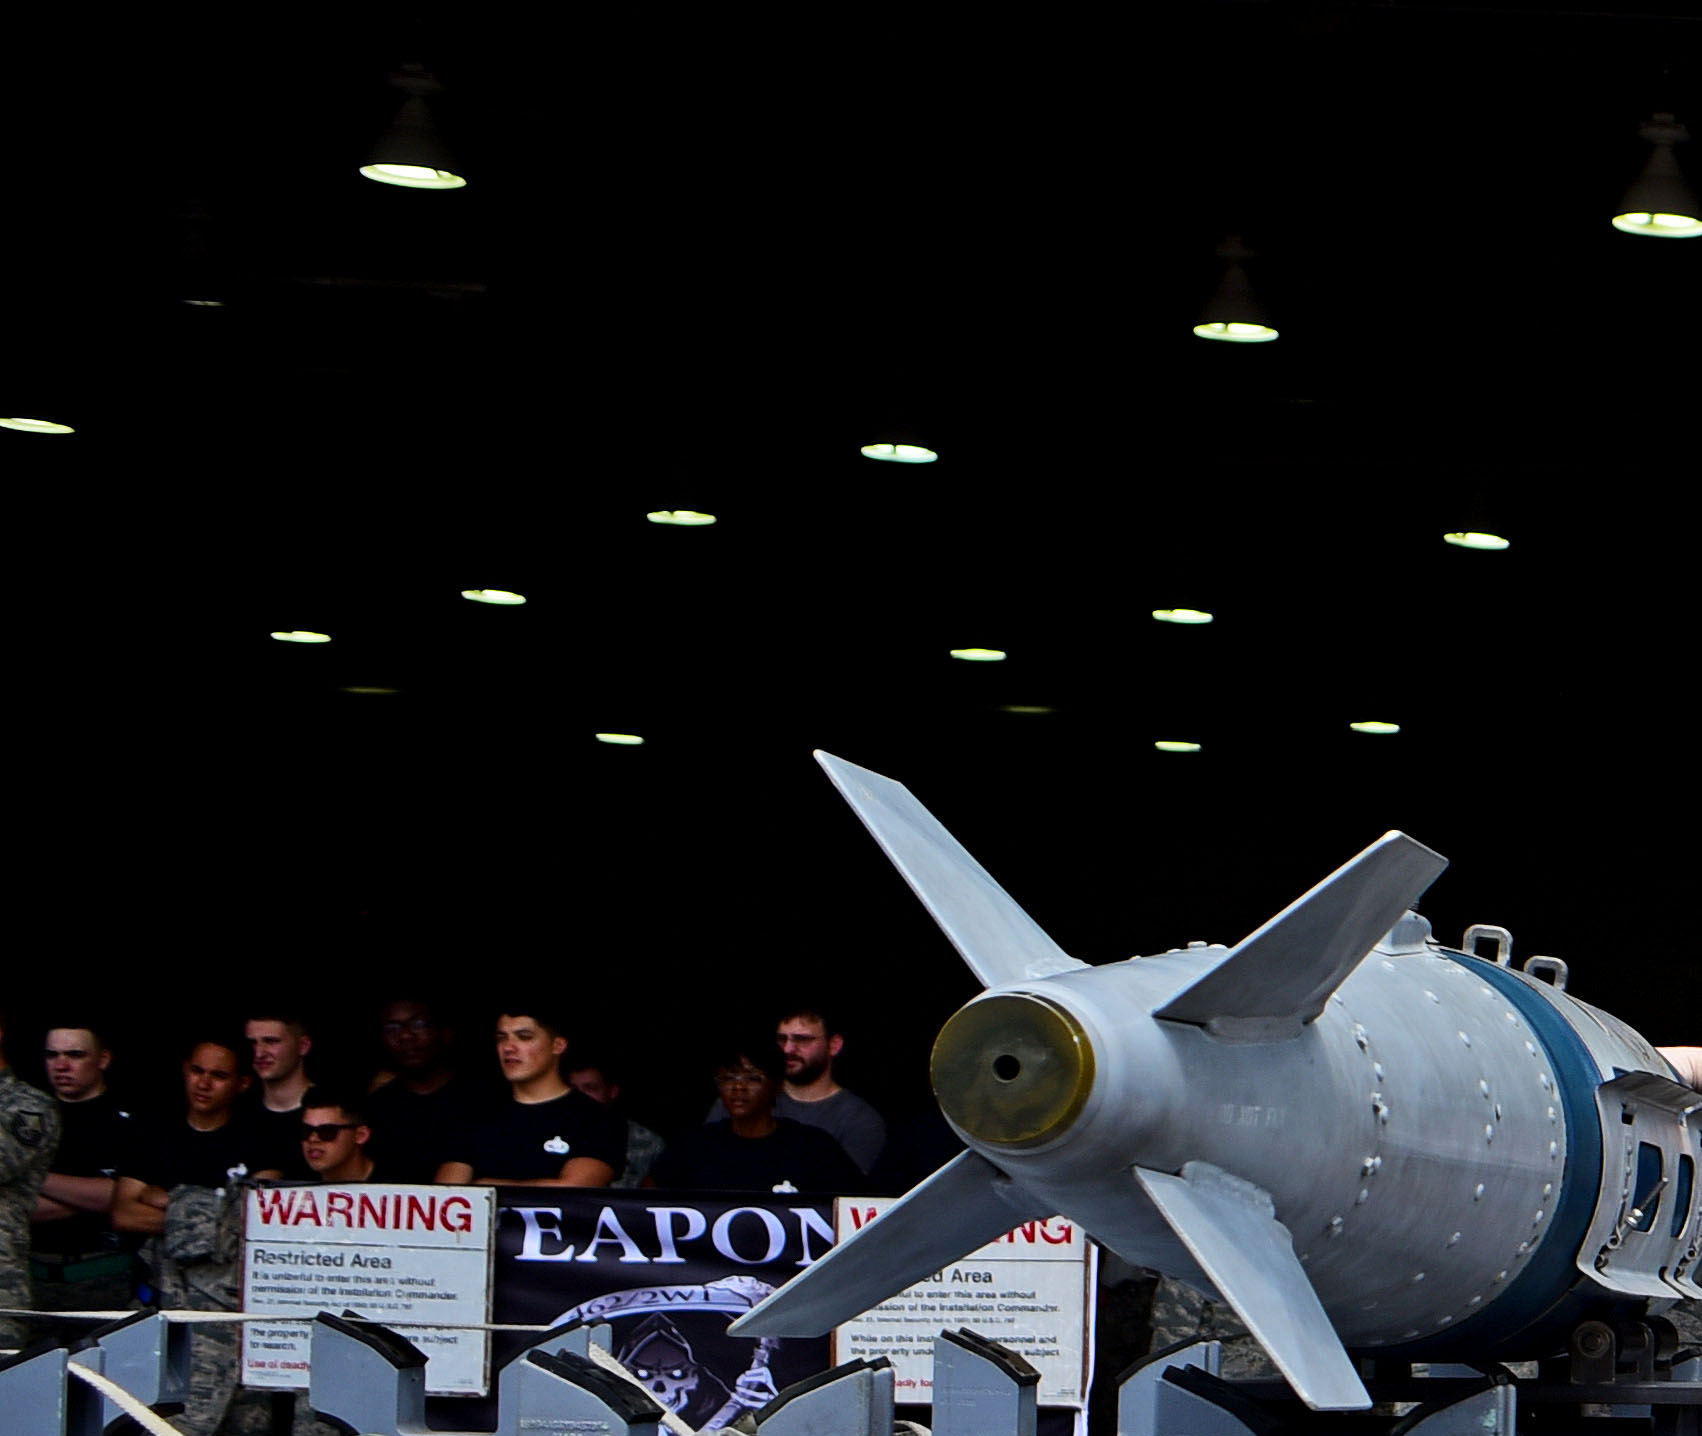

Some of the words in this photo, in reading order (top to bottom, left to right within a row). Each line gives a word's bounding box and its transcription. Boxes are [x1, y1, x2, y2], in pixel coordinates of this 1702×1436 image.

[257, 1188, 473, 1233] WARNING
[499, 1206, 834, 1265] EAPON
[253, 1249, 344, 1268] Restricted
[350, 1253, 392, 1269] Area
[951, 1268, 993, 1283] Area
